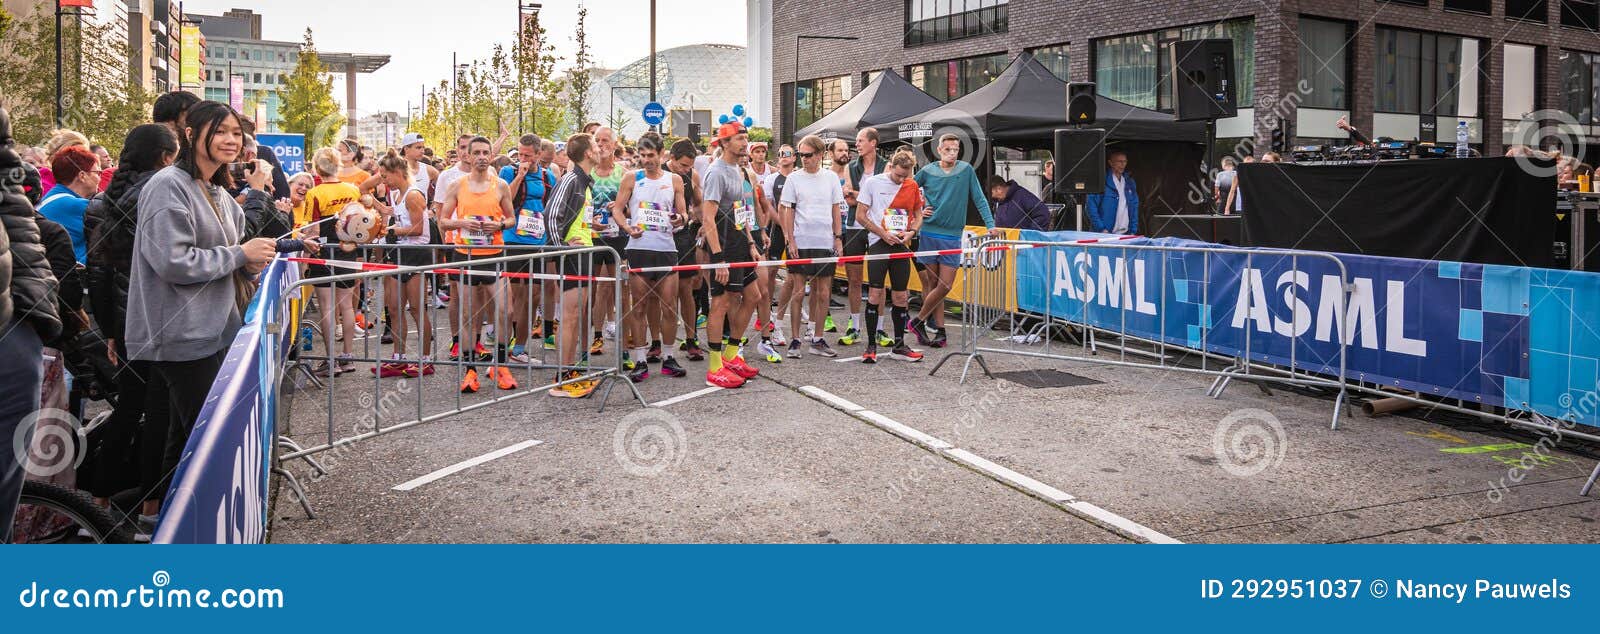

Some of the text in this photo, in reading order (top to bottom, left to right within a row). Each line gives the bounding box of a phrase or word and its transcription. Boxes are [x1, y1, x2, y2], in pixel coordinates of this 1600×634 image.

[272, 146, 302, 157] OED
[289, 161, 302, 172] JE
[1053, 250, 1157, 315] ASML
[1231, 268, 1427, 357] ASML
